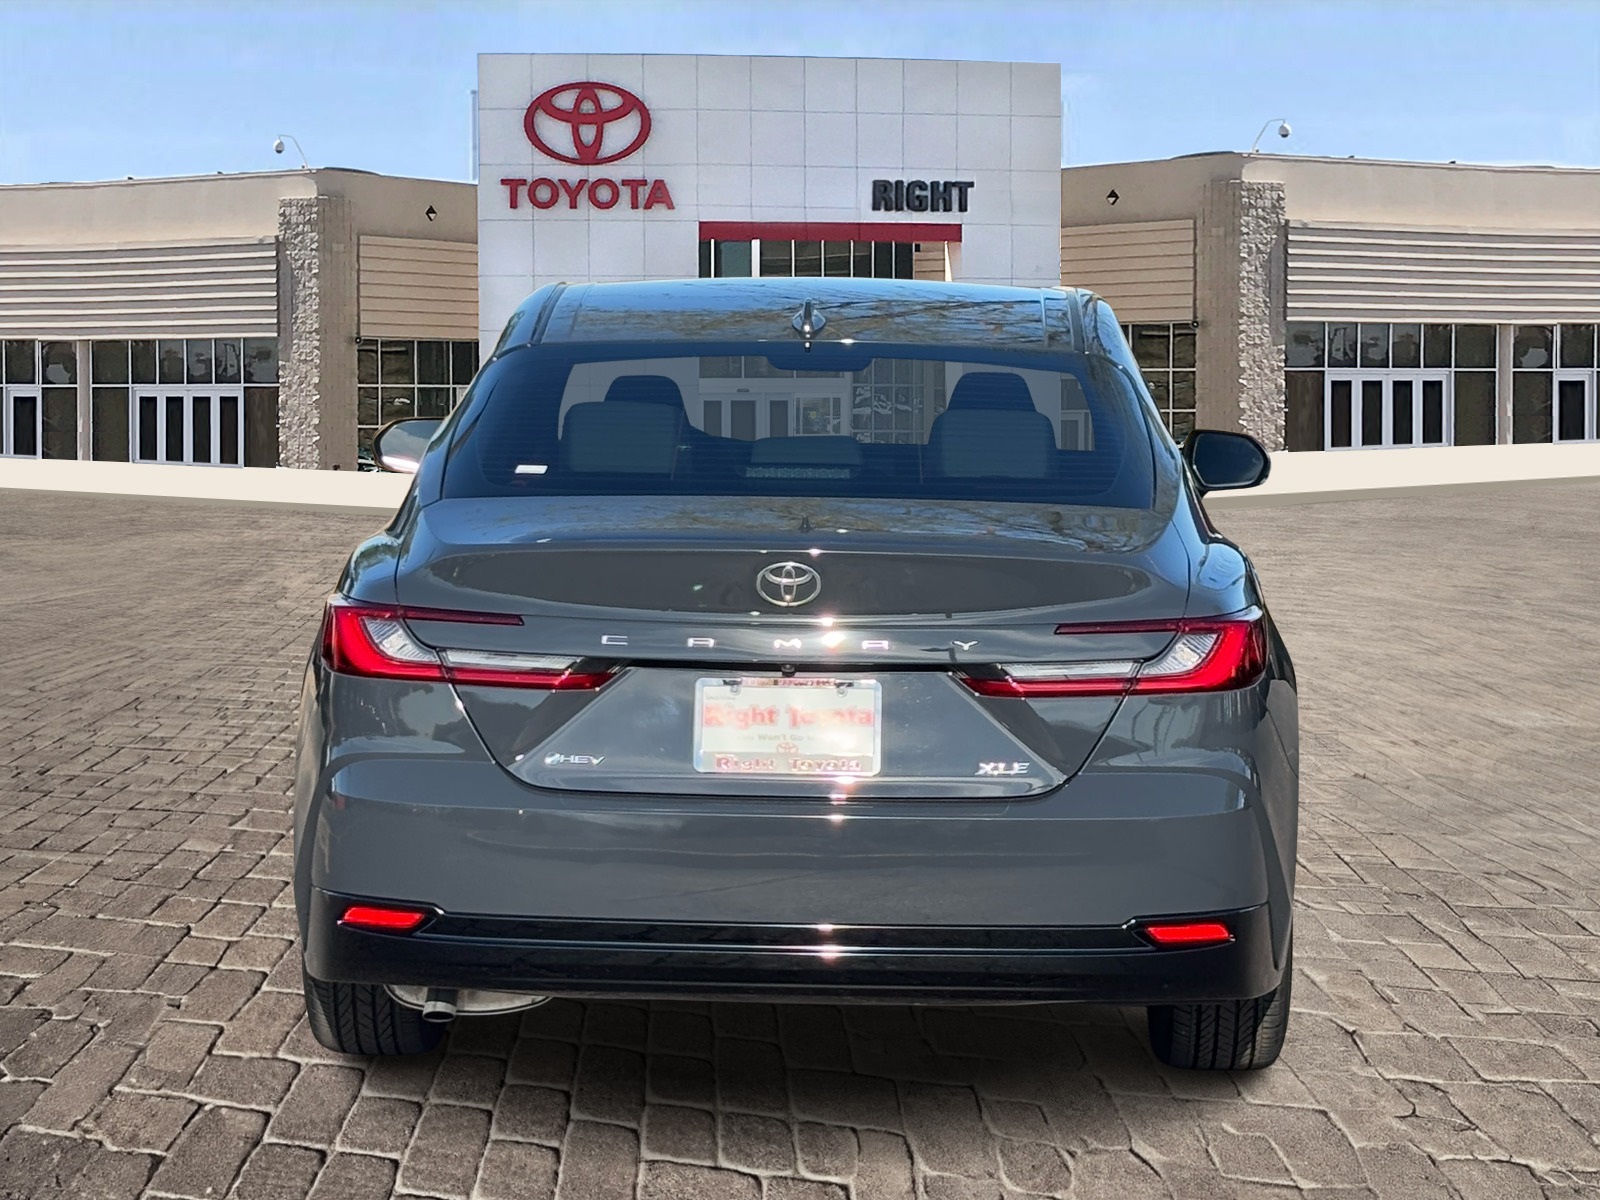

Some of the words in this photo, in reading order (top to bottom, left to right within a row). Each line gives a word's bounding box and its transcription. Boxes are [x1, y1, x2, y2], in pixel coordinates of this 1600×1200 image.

[500, 177, 676, 210] TOYOTA
[871, 179, 975, 213] RIGHT
[600, 633, 980, 652] CAMRY
[714, 753, 777, 773] Right
[788, 756, 862, 773] Toyota
[974, 761, 1030, 776] XLE
